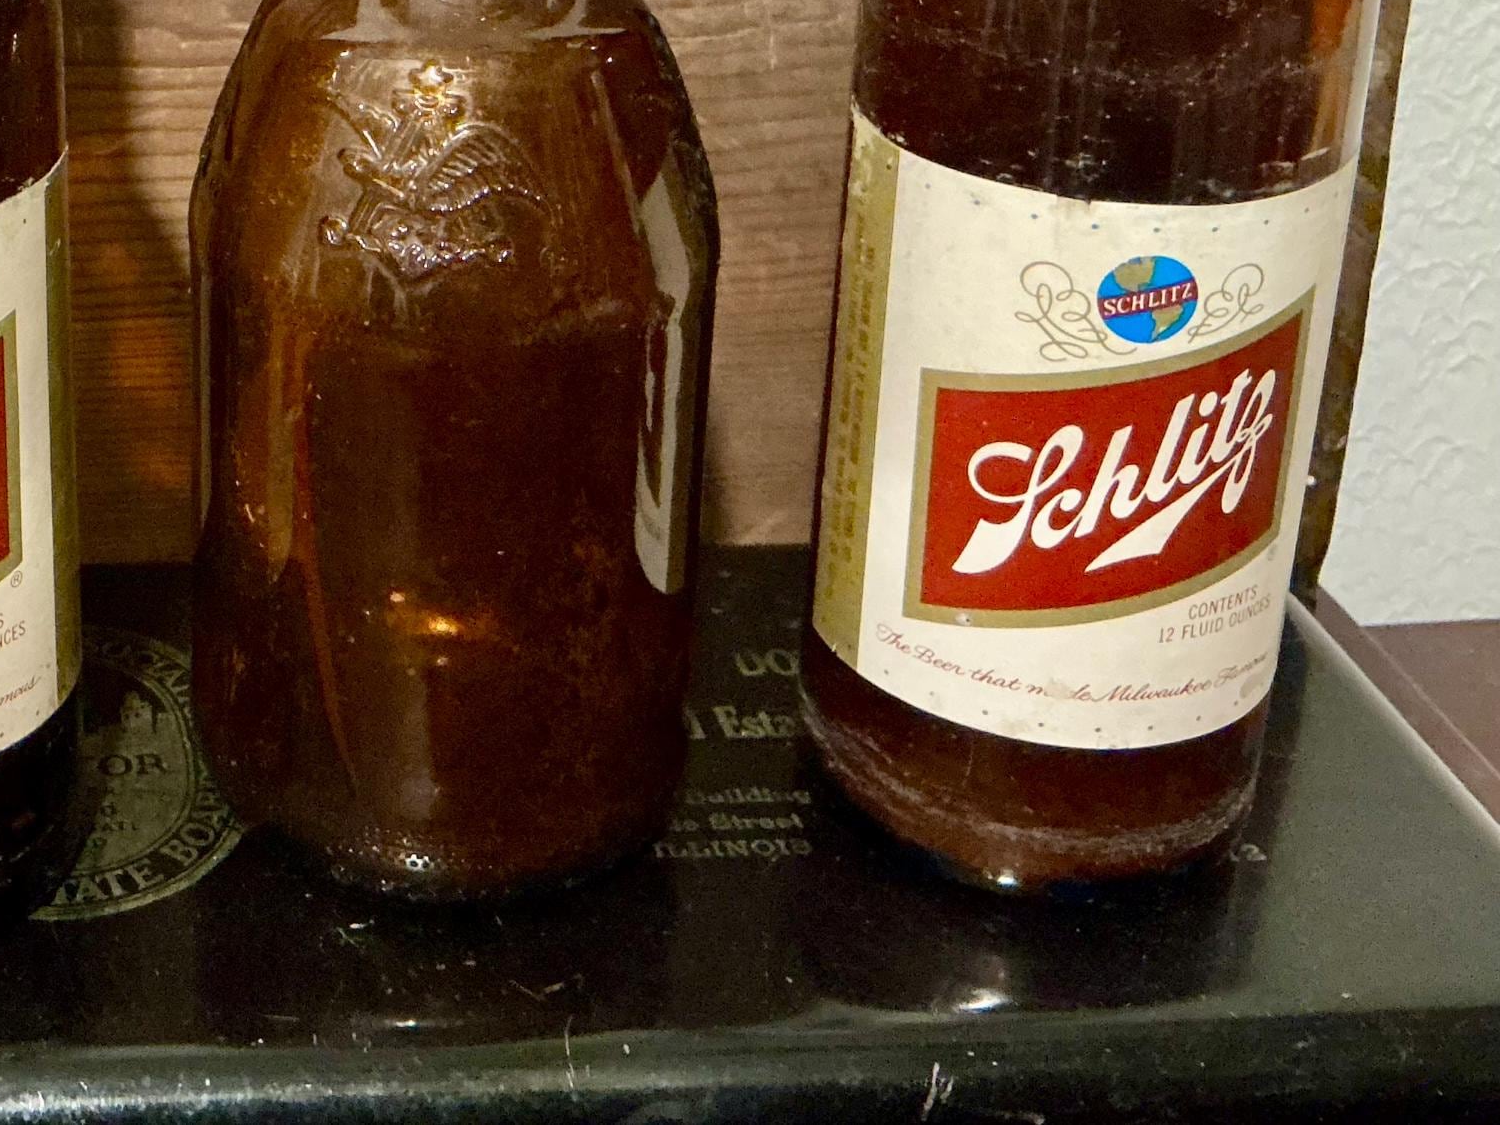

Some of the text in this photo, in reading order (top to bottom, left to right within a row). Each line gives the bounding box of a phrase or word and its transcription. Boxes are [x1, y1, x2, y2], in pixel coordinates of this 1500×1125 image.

[1103, 281, 1193, 318] SCHLITZ
[950, 368, 1277, 574] Schlitz
[1158, 592, 1272, 644] 12 FLUID OUNCES
[1187, 583, 1259, 620] CONTENTS
[875, 623, 911, 654] The
[910, 644, 965, 676] Beer
[968, 667, 1023, 691] that
[1090, 677, 1214, 703] Milwaukee
